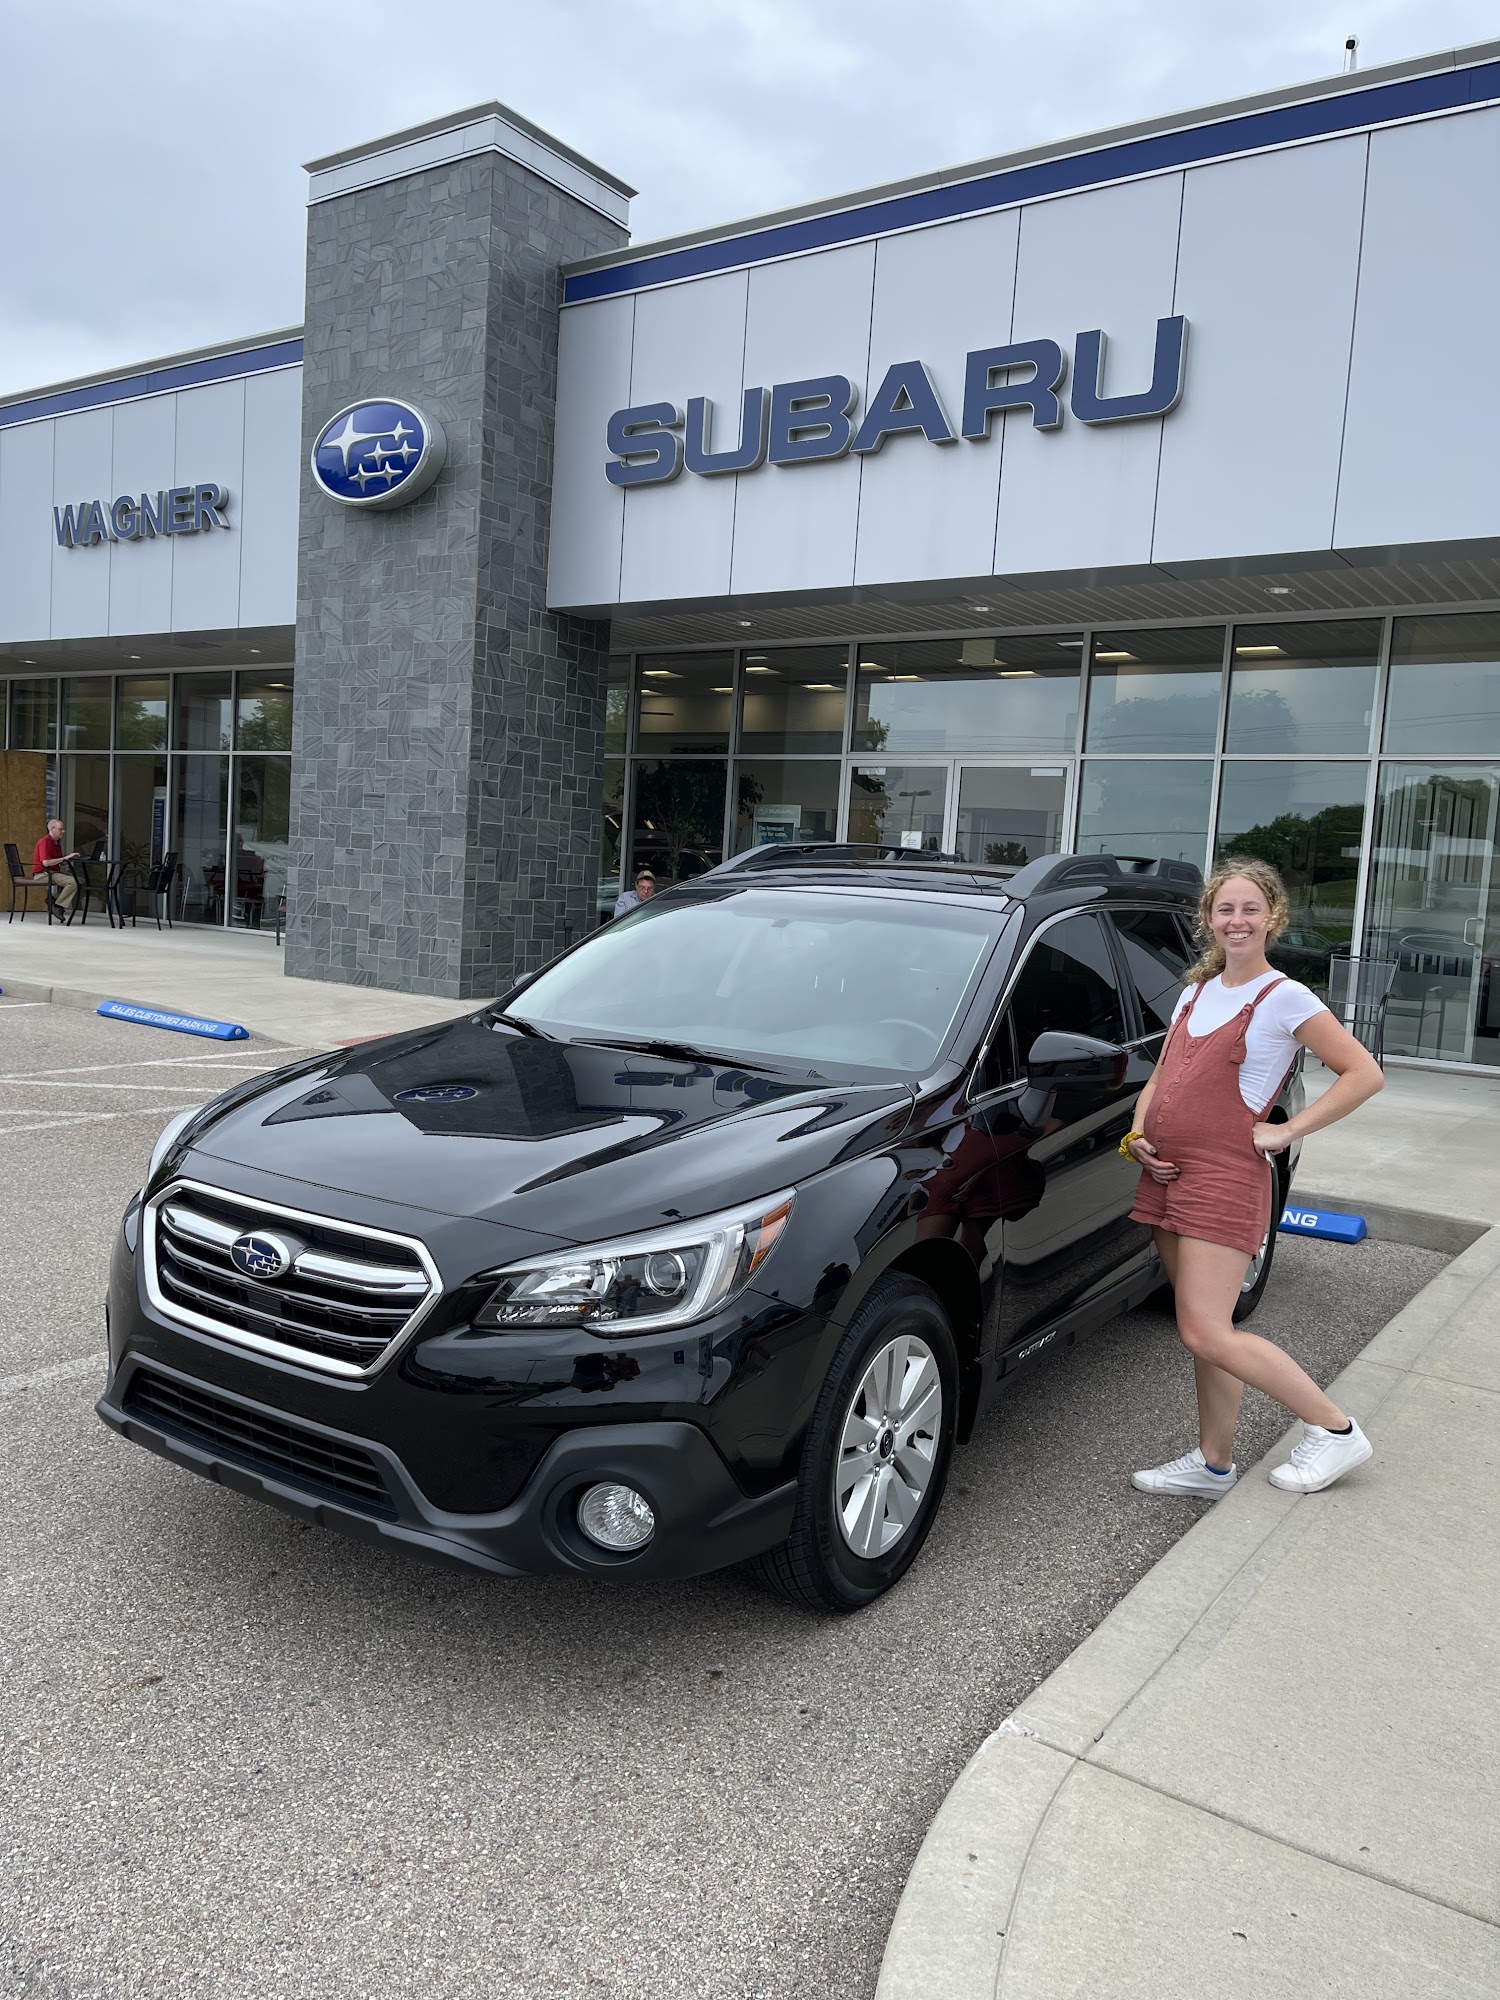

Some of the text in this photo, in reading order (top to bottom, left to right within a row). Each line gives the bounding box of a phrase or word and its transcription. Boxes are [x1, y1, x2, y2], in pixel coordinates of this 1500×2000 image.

[604, 314, 1190, 488] SUBARU
[53, 483, 230, 548] WAGNER
[108, 1004, 218, 1033] SALES CUSTOMER PARKING
